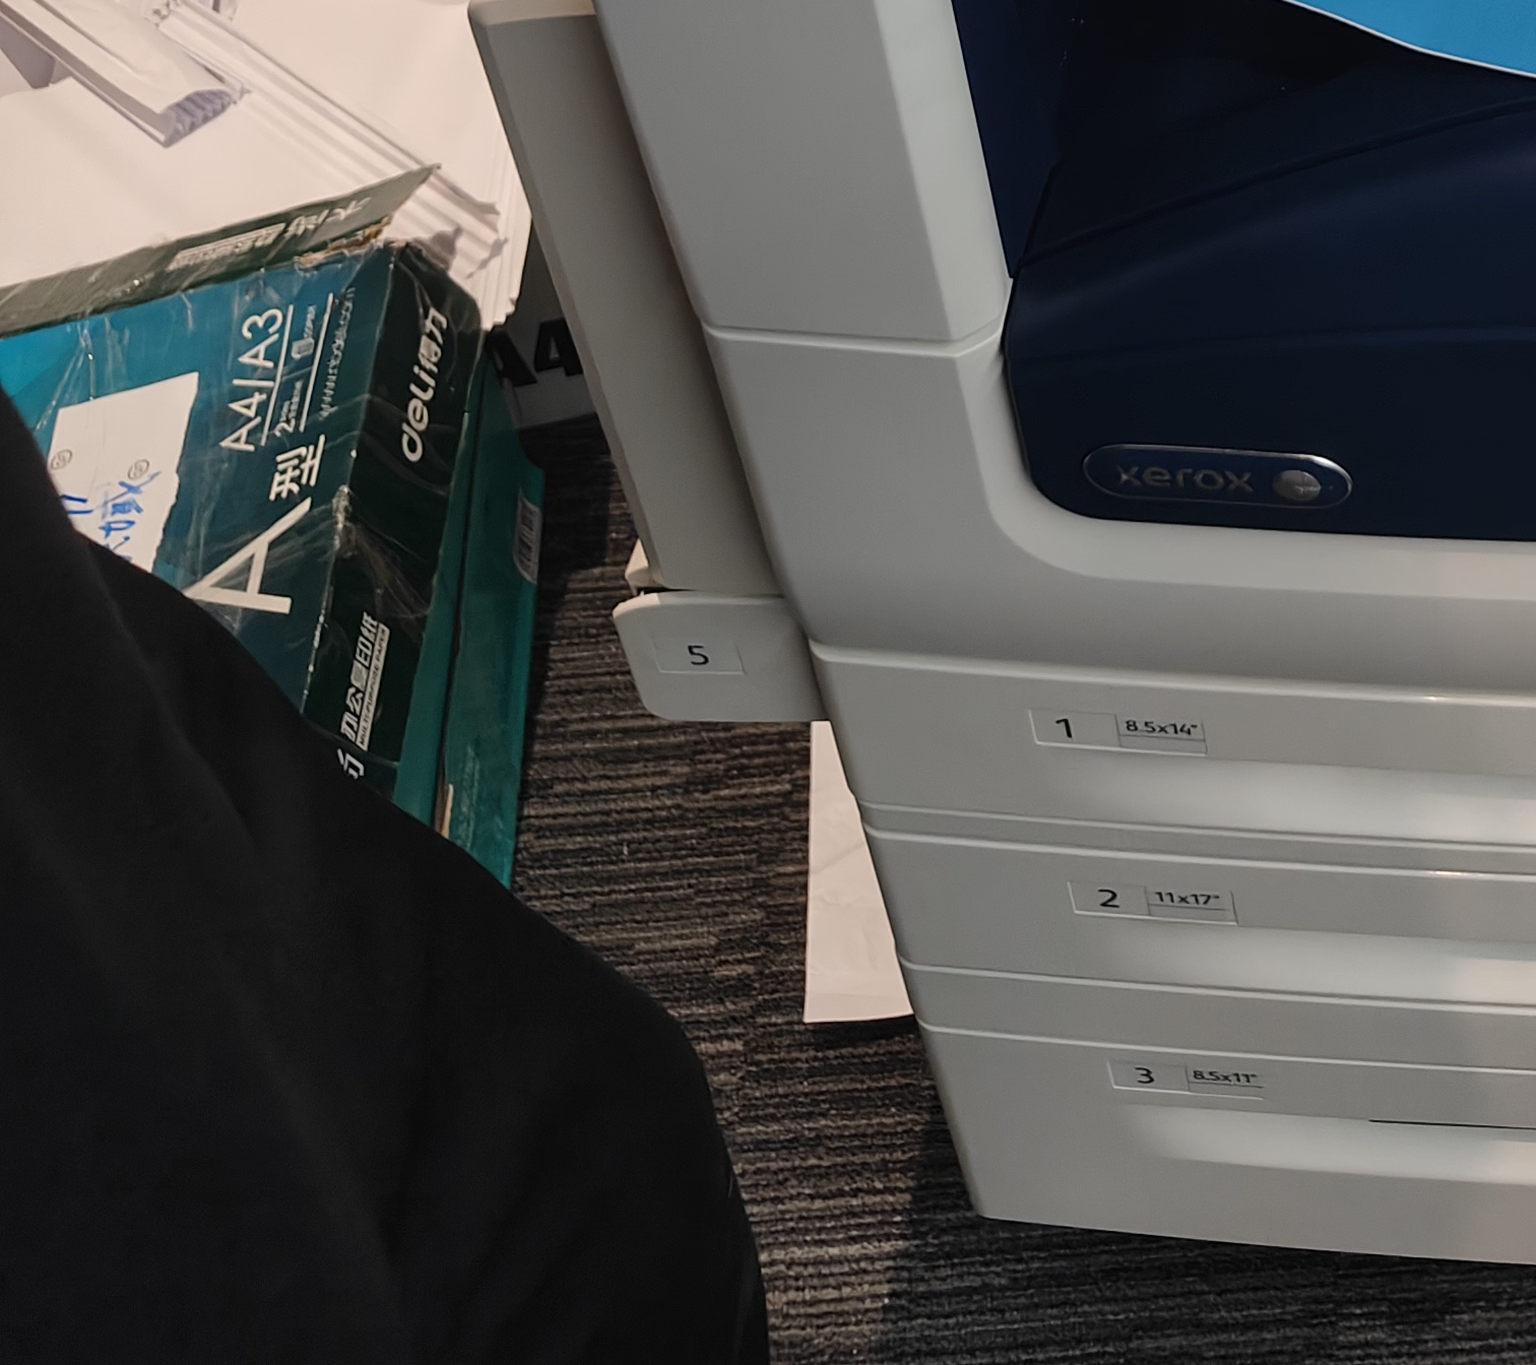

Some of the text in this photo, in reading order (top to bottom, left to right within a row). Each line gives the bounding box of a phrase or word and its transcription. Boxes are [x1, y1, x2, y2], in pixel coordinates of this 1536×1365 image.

[1117, 464, 1254, 492] xerox
[687, 644, 709, 666] 5
[1055, 718, 1073, 738] 1
[1098, 889, 1120, 908] 2
[1134, 1067, 1155, 1084] 3
